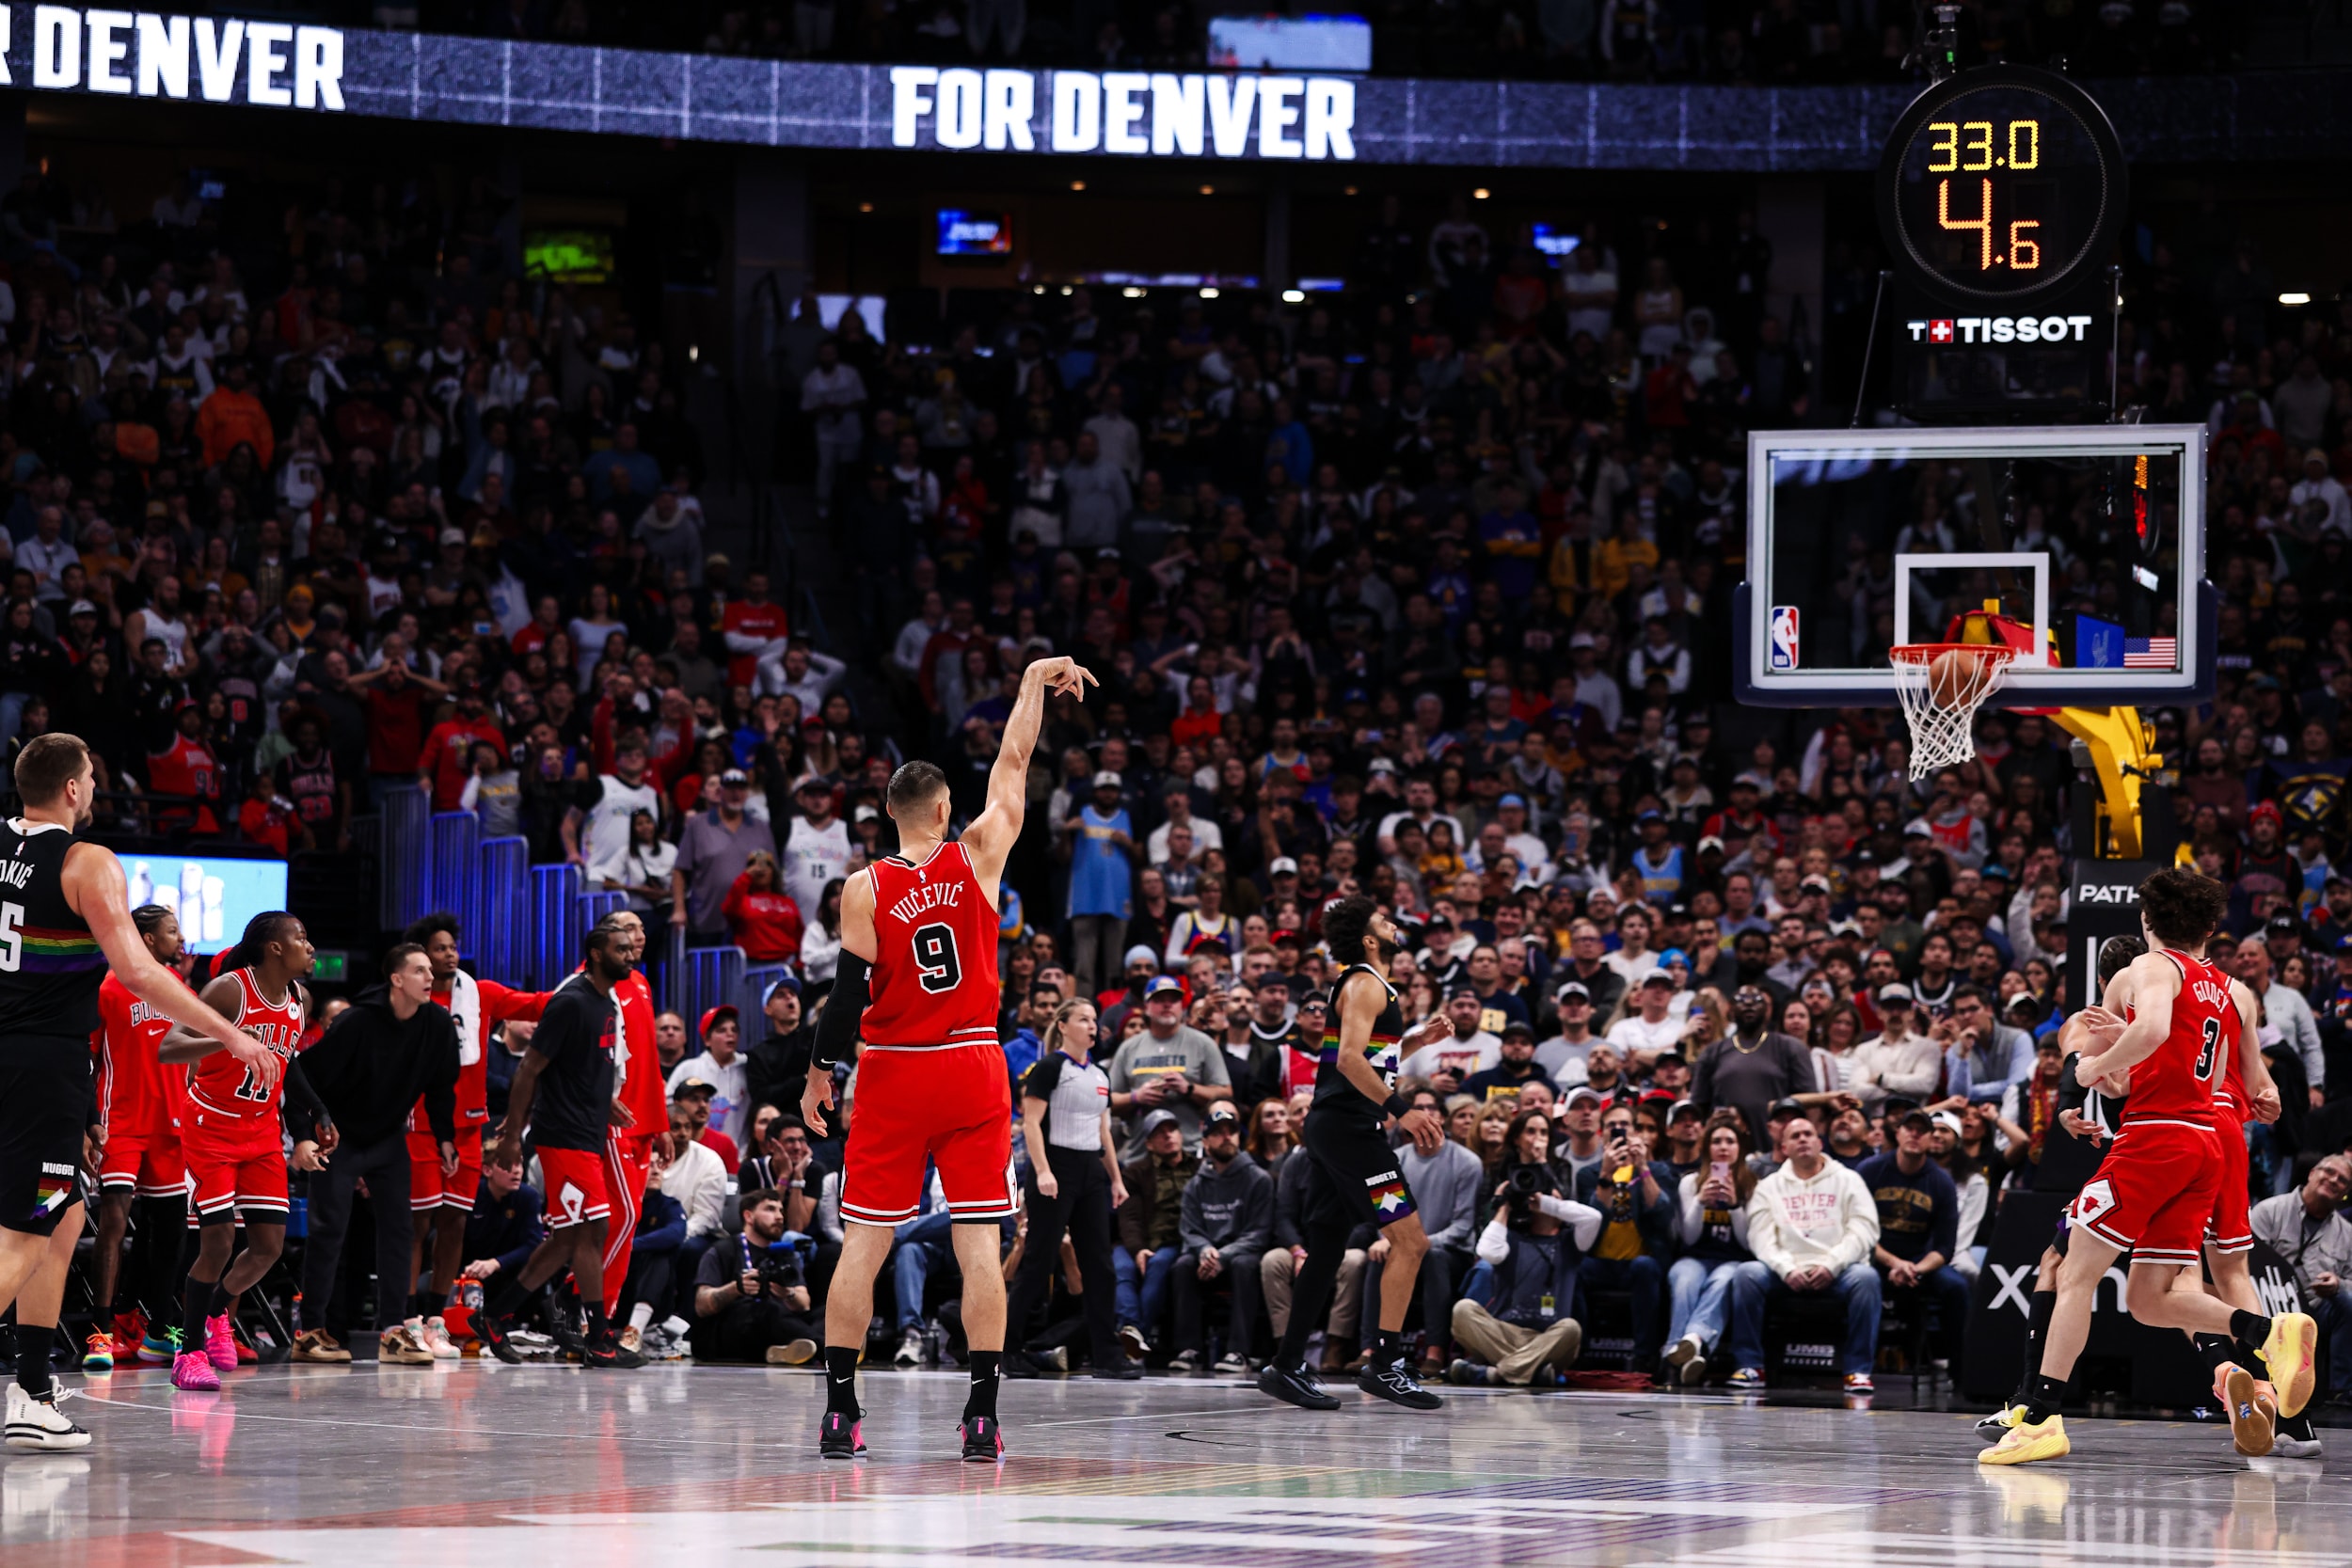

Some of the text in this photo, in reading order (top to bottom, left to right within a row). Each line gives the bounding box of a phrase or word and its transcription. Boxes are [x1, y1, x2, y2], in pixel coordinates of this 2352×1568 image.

[33, 4, 345, 111] DENVER
[890, 65, 1357, 161] FOR DENVER
[1928, 119, 2040, 173] 33.0
[1938, 177, 2041, 271] 4.6
[1957, 315, 2092, 344] TISSOT
[889, 880, 965, 924] VUČEVIĆ
[912, 922, 963, 995] 9
[2192, 980, 2230, 1014] GIDDEY
[2194, 1016, 2221, 1083] 3
[1364, 1169, 1399, 1187] NUGGETS
[1786, 1343, 1836, 1354] UMB
